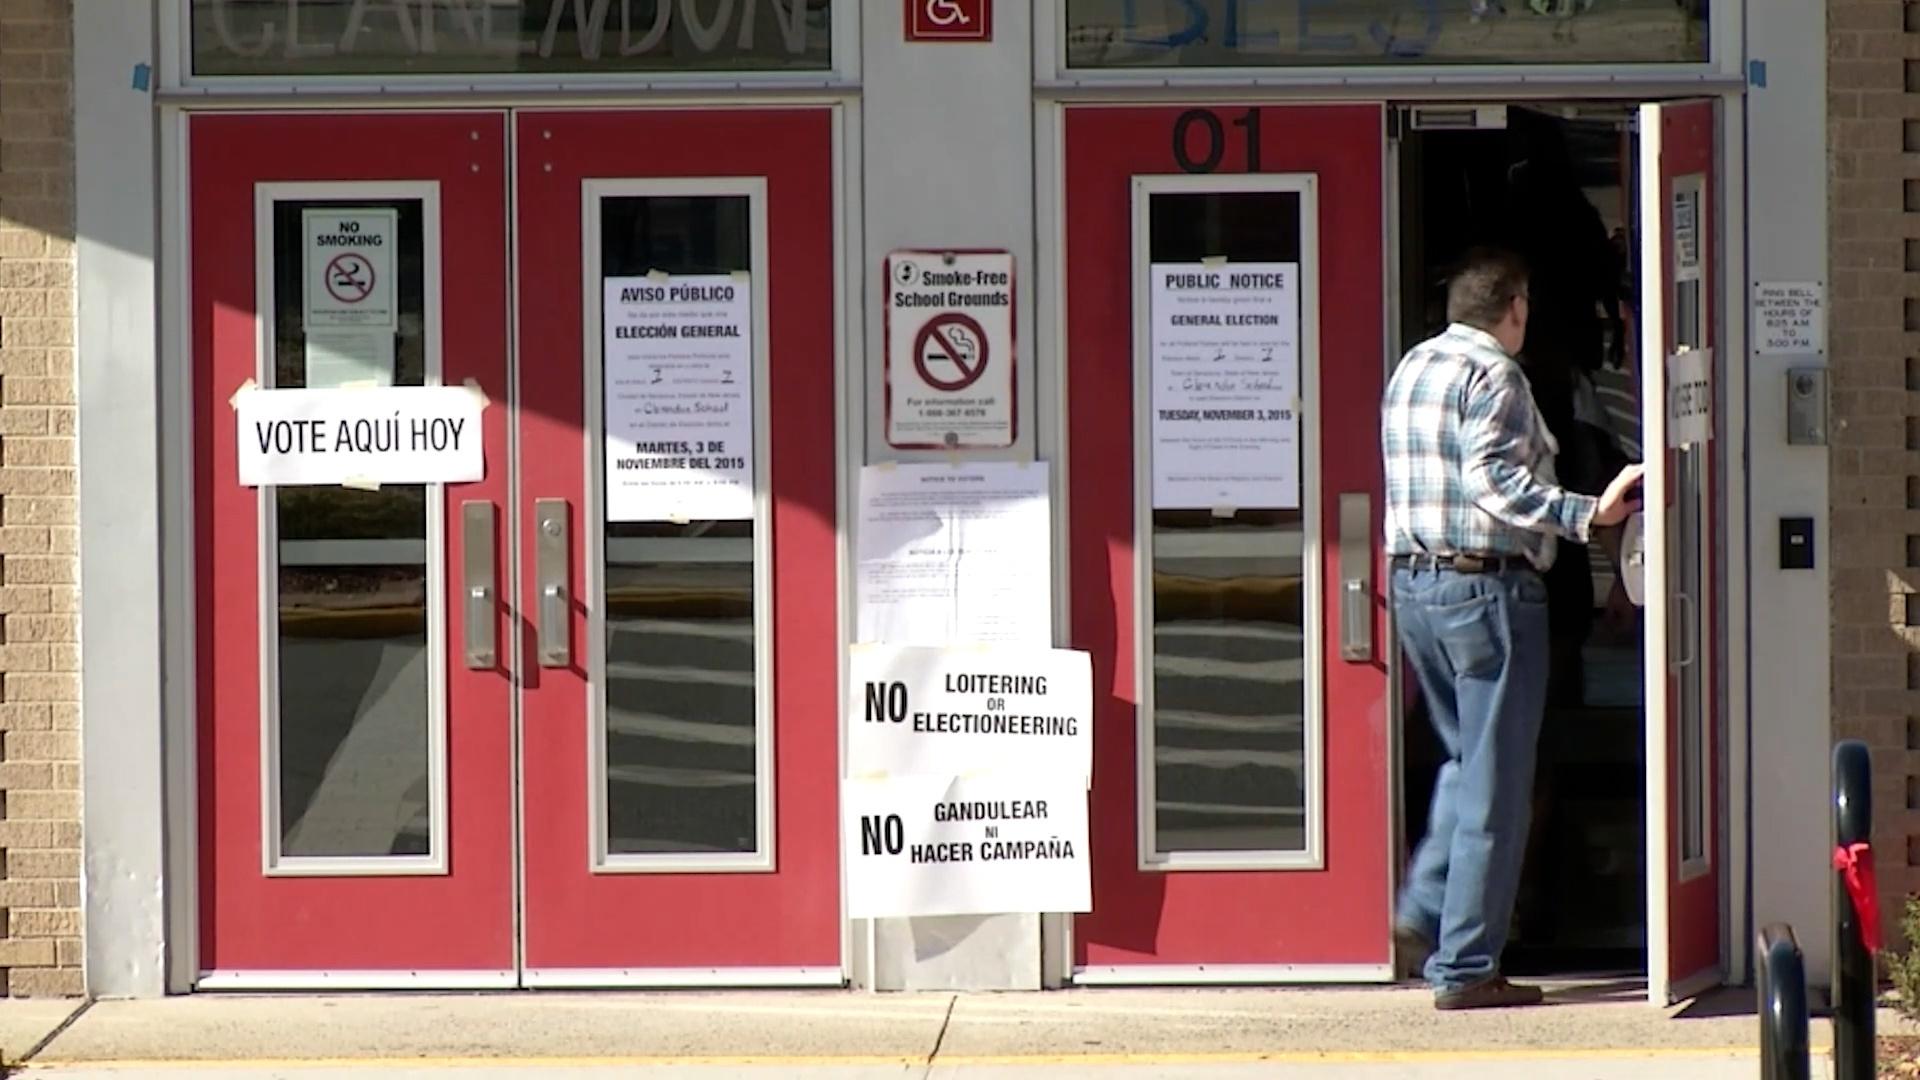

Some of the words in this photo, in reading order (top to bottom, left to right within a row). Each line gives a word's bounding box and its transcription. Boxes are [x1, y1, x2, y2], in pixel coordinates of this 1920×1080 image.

[1173, 107, 1262, 173] 01
[339, 221, 360, 233] NO
[316, 235, 383, 247] SMOKING
[922, 270, 1008, 286] Smoke-Free
[1165, 273, 1220, 288] PUBLIC
[1230, 273, 1284, 288] NOTICE
[620, 287, 665, 302] AVISO
[669, 283, 735, 302] PÚBLICO
[894, 292, 945, 308] School
[948, 291, 1009, 307] Grounds
[1170, 314, 1222, 326] GENERAL
[1226, 314, 1279, 325] ELECTION
[615, 323, 677, 338] ELECCIÓN
[681, 325, 740, 338] GENERAL
[1158, 409, 1201, 423] TUESDAY,
[1203, 409, 1255, 421] NOVEMBER
[1257, 410, 1266, 422] 3,
[1268, 409, 1292, 421] 2015
[256, 420, 327, 454] VOTE
[334, 410, 401, 453] AQUÍ
[411, 418, 465, 452] HOY
[636, 442, 692, 455] MARTES,
[696, 442, 704, 453] 3
[708, 441, 724, 453] DE
[616, 458, 686, 470] NOVIEMBRE
[689, 458, 712, 469] DEL
[714, 458, 744, 469] 2015
[945, 673, 1047, 695] LOITERING
[864, 681, 908, 723] NO
[987, 698, 1005, 711] OR
[913, 714, 1078, 736] ELECTIONEERING
[934, 800, 1048, 822] GANDULEAR
[861, 813, 904, 856] NO
[985, 826, 999, 838] NI
[911, 843, 973, 863] HACER
[980, 835, 1075, 861] CAMPAÑA
